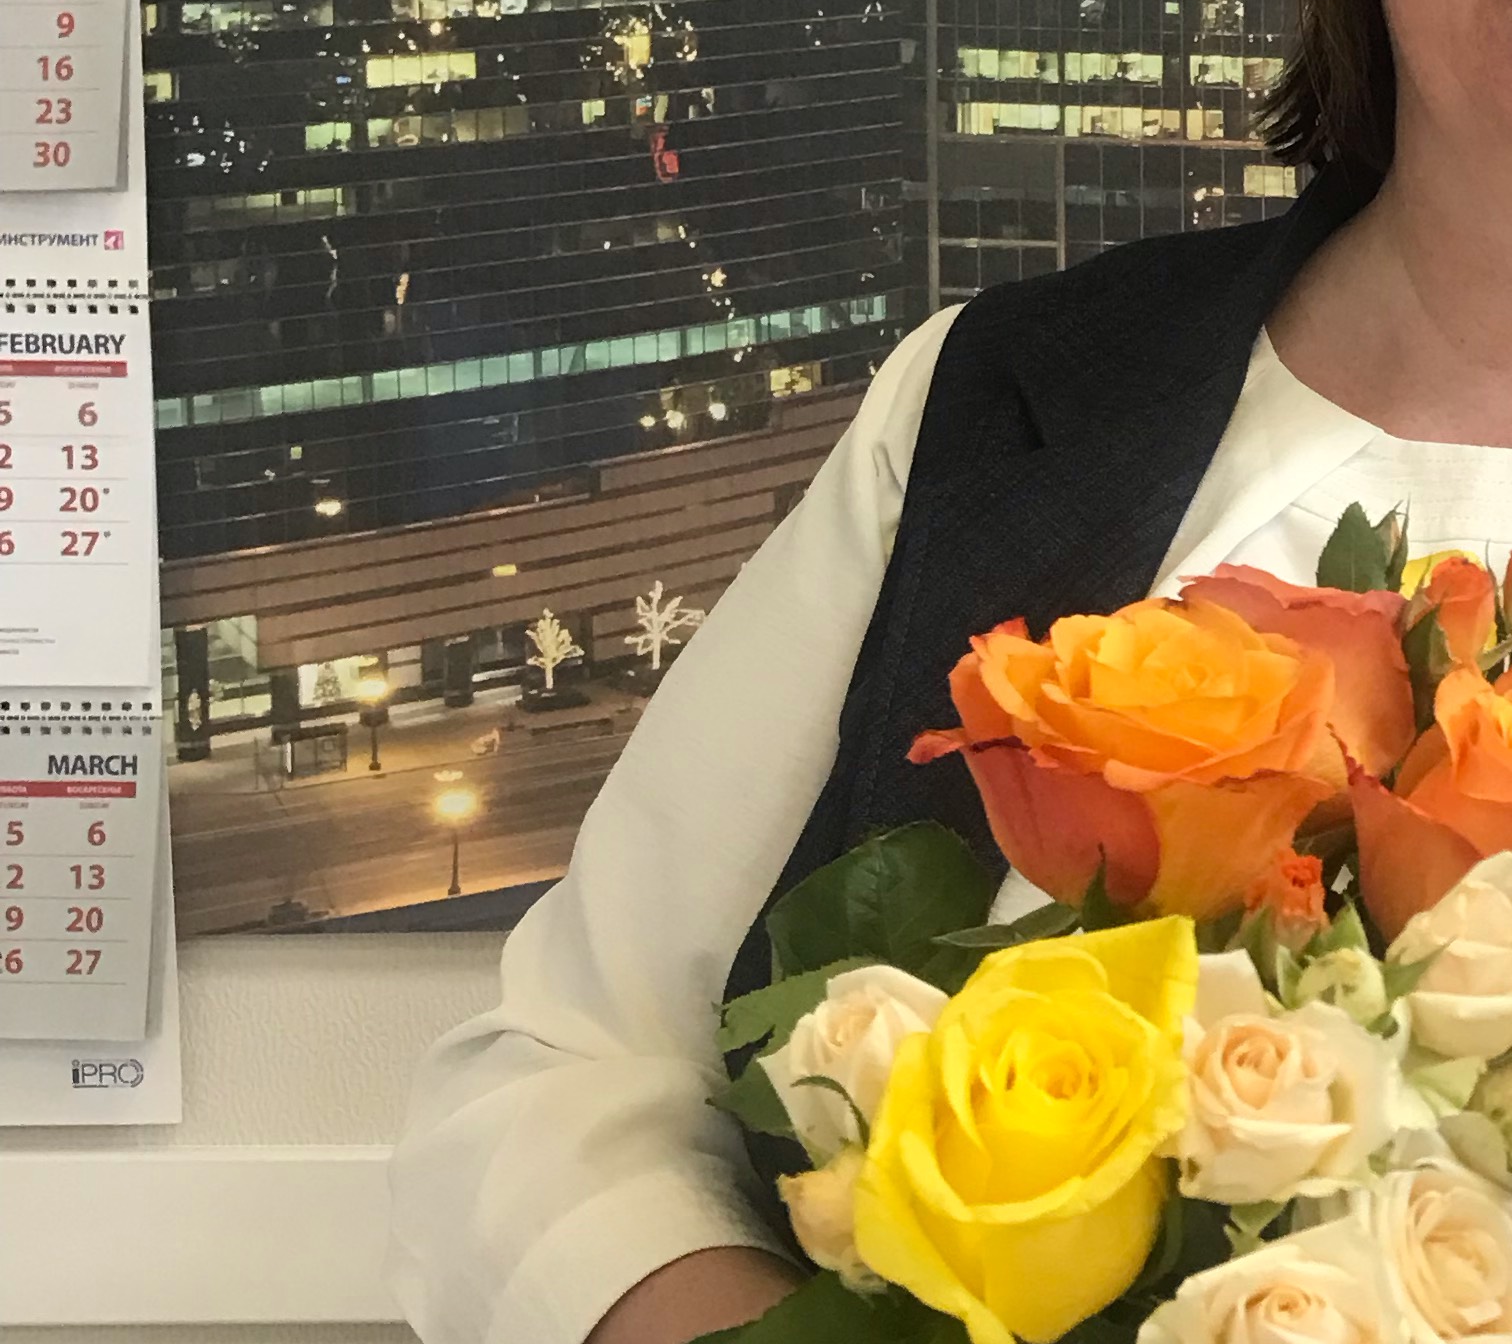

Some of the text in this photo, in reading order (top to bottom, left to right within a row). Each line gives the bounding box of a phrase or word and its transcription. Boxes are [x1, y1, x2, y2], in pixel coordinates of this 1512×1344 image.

[57, 12, 75, 38] 9
[37, 55, 74, 81] 16
[35, 98, 72, 124] 23
[33, 141, 71, 168] 30
[0, 333, 126, 354] FEBRUARY
[78, 401, 98, 427] 6
[61, 444, 99, 470] 13
[59, 486, 99, 513] 20
[60, 530, 100, 556] 27
[47, 754, 138, 776] MARCH
[6, 820, 106, 846] 5 6
[6, 863, 105, 890] 2 13
[5, 906, 104, 933] 9 20
[0, 948, 102, 975] 6 27
